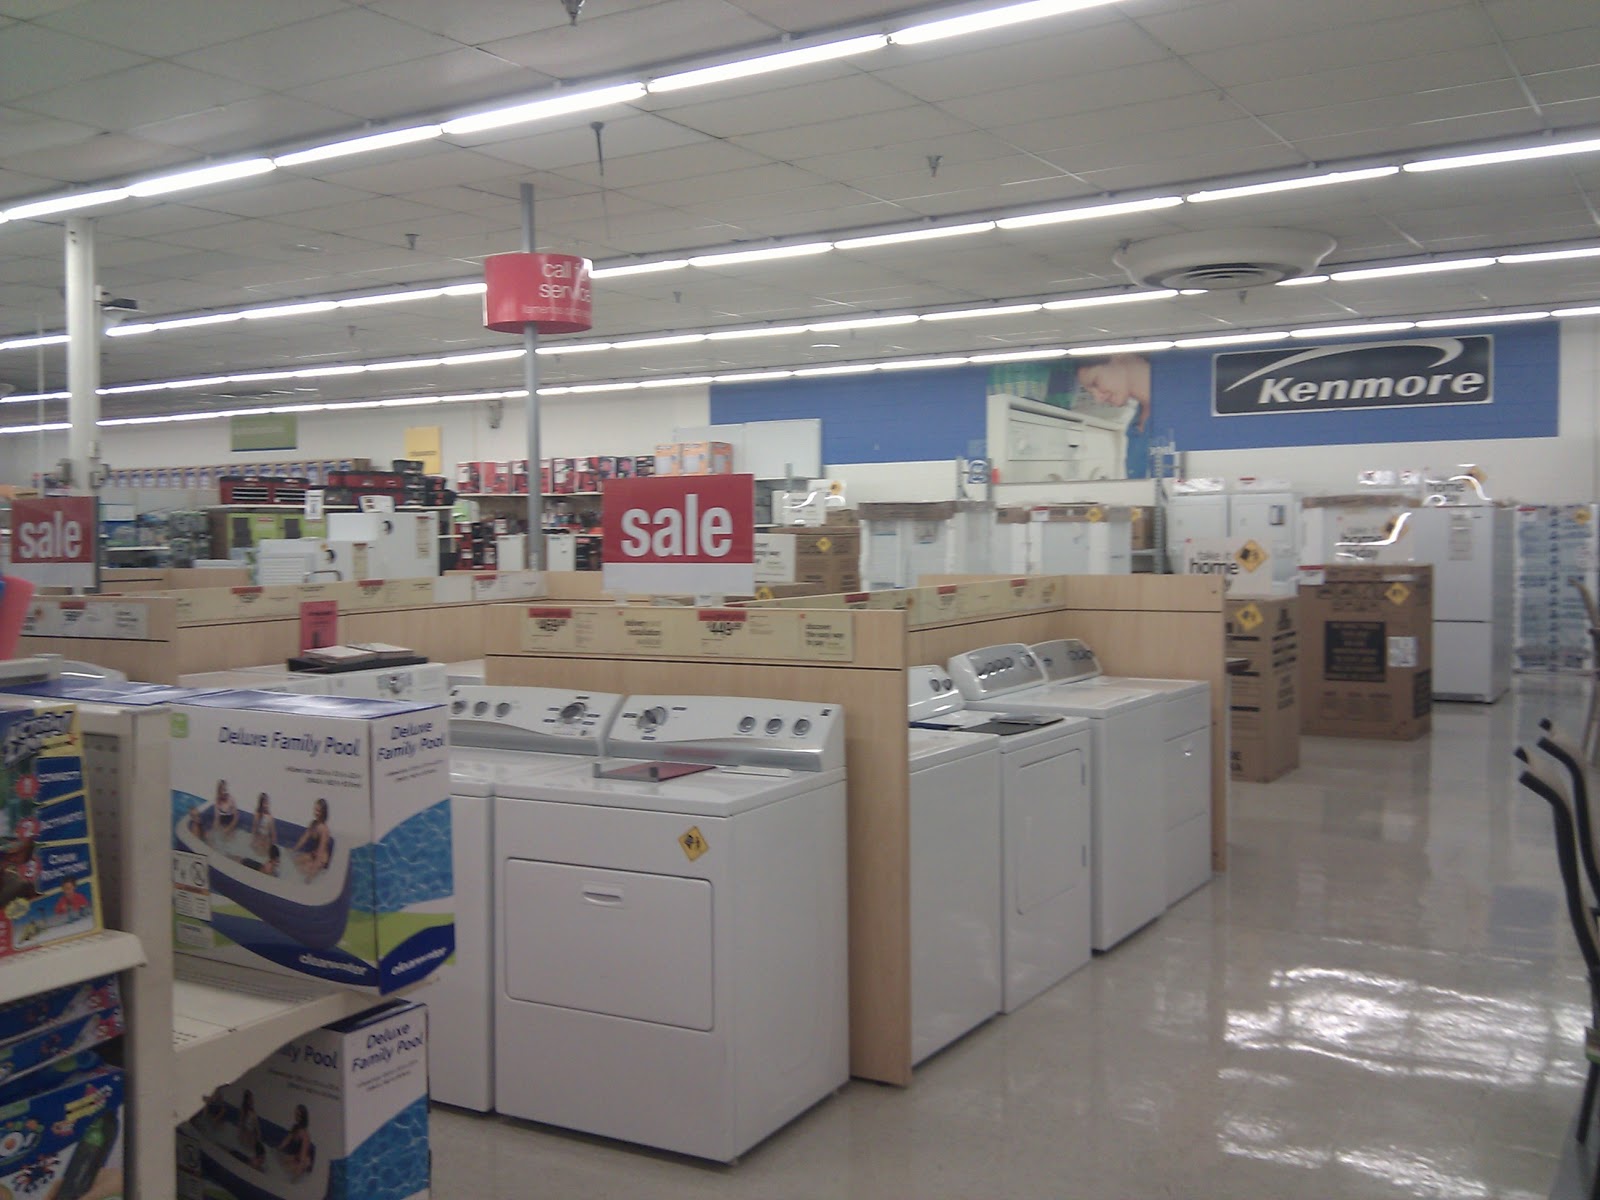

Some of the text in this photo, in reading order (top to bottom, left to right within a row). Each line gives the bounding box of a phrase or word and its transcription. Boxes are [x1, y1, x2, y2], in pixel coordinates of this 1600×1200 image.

[542, 261, 572, 279] call
[539, 283, 592, 303] servce
[1258, 371, 1486, 405] Kenmore
[18, 510, 82, 560] sale
[620, 493, 734, 558] sale
[1188, 557, 1239, 575] home
[218, 726, 362, 757] Deluxe Family Pool
[390, 720, 433, 741] Deluxe
[376, 731, 446, 762] Family Pool
[366, 1023, 411, 1050] Deluxe
[304, 1044, 338, 1070] Pool
[352, 1032, 424, 1073] Family Pool
